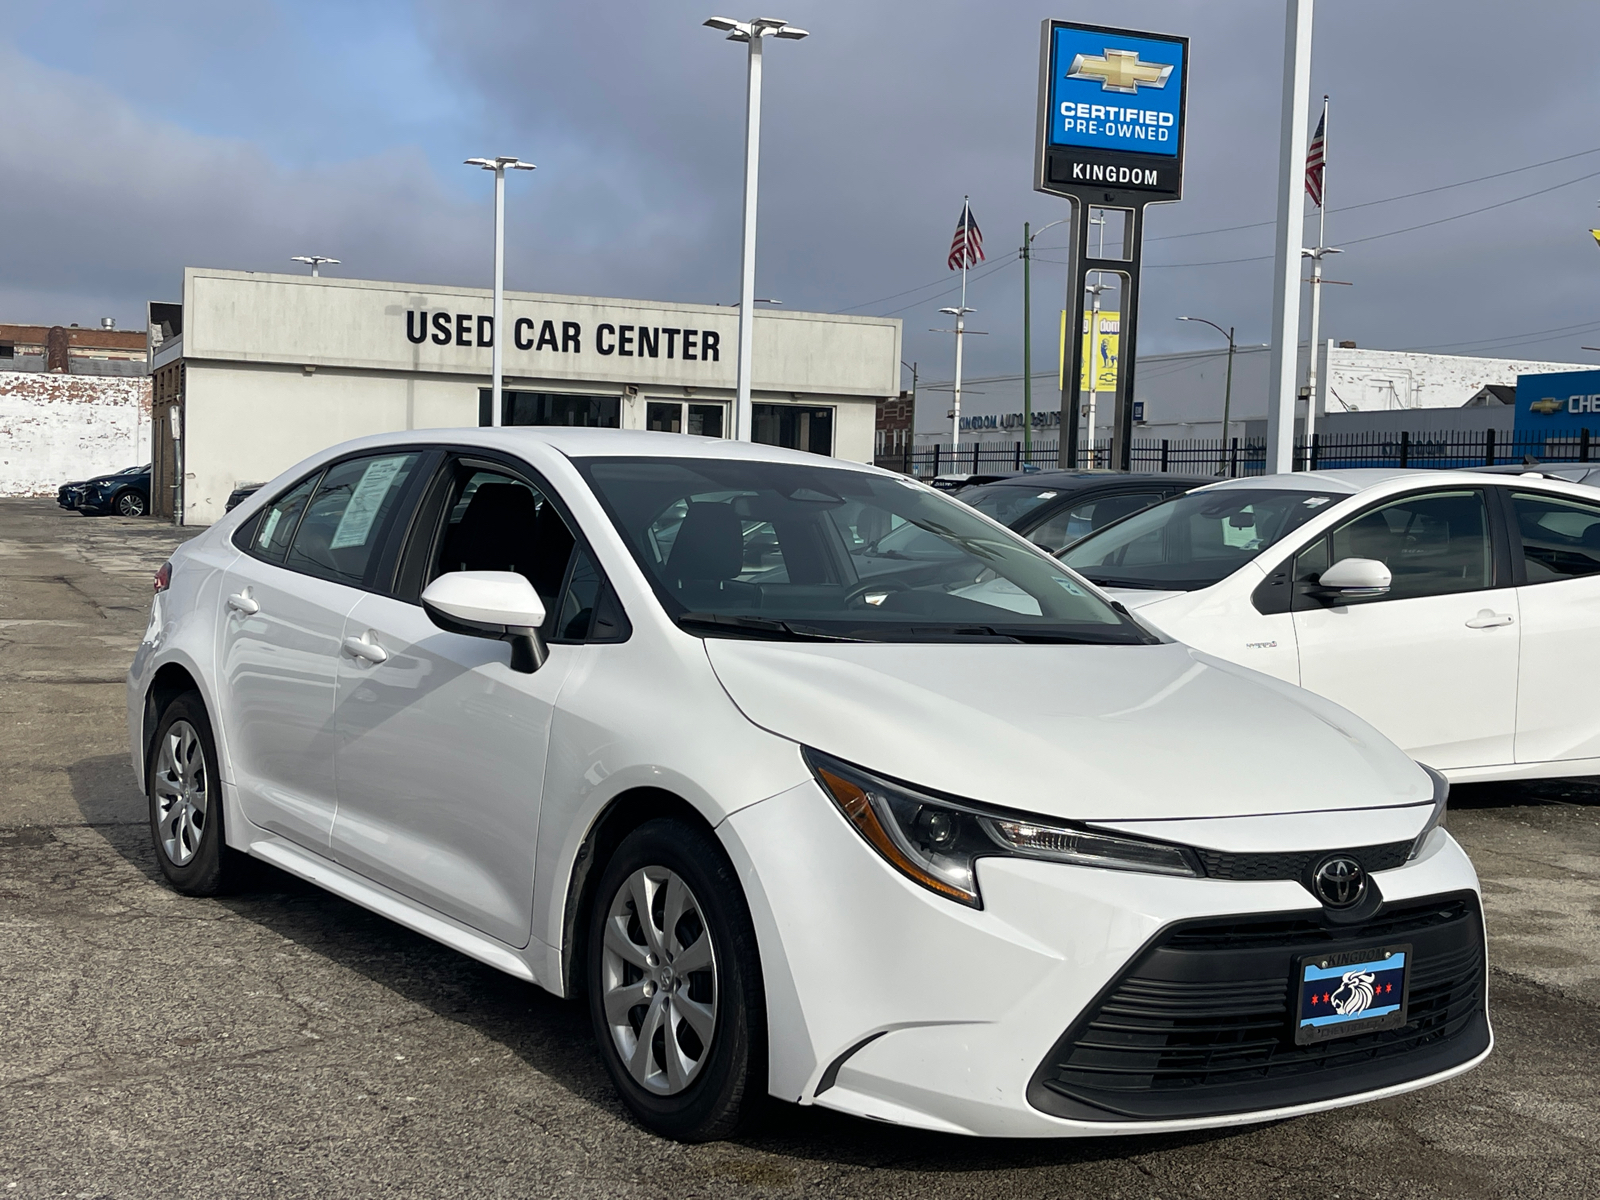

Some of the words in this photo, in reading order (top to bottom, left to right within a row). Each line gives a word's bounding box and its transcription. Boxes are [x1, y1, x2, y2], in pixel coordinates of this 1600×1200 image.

[1060, 101, 1174, 126] CERTIFIED
[1064, 118, 1169, 141] PRE-OWNED
[1072, 163, 1158, 186] KINGDOM
[406, 310, 494, 348] USED
[514, 317, 582, 353] CAR
[595, 323, 720, 362] CENTER
[959, 414, 998, 430] KINGDOM
[1000, 412, 1025, 429] AUTO
[1030, 411, 1061, 427] CENTE
[1327, 948, 1386, 966] KINGDOM
